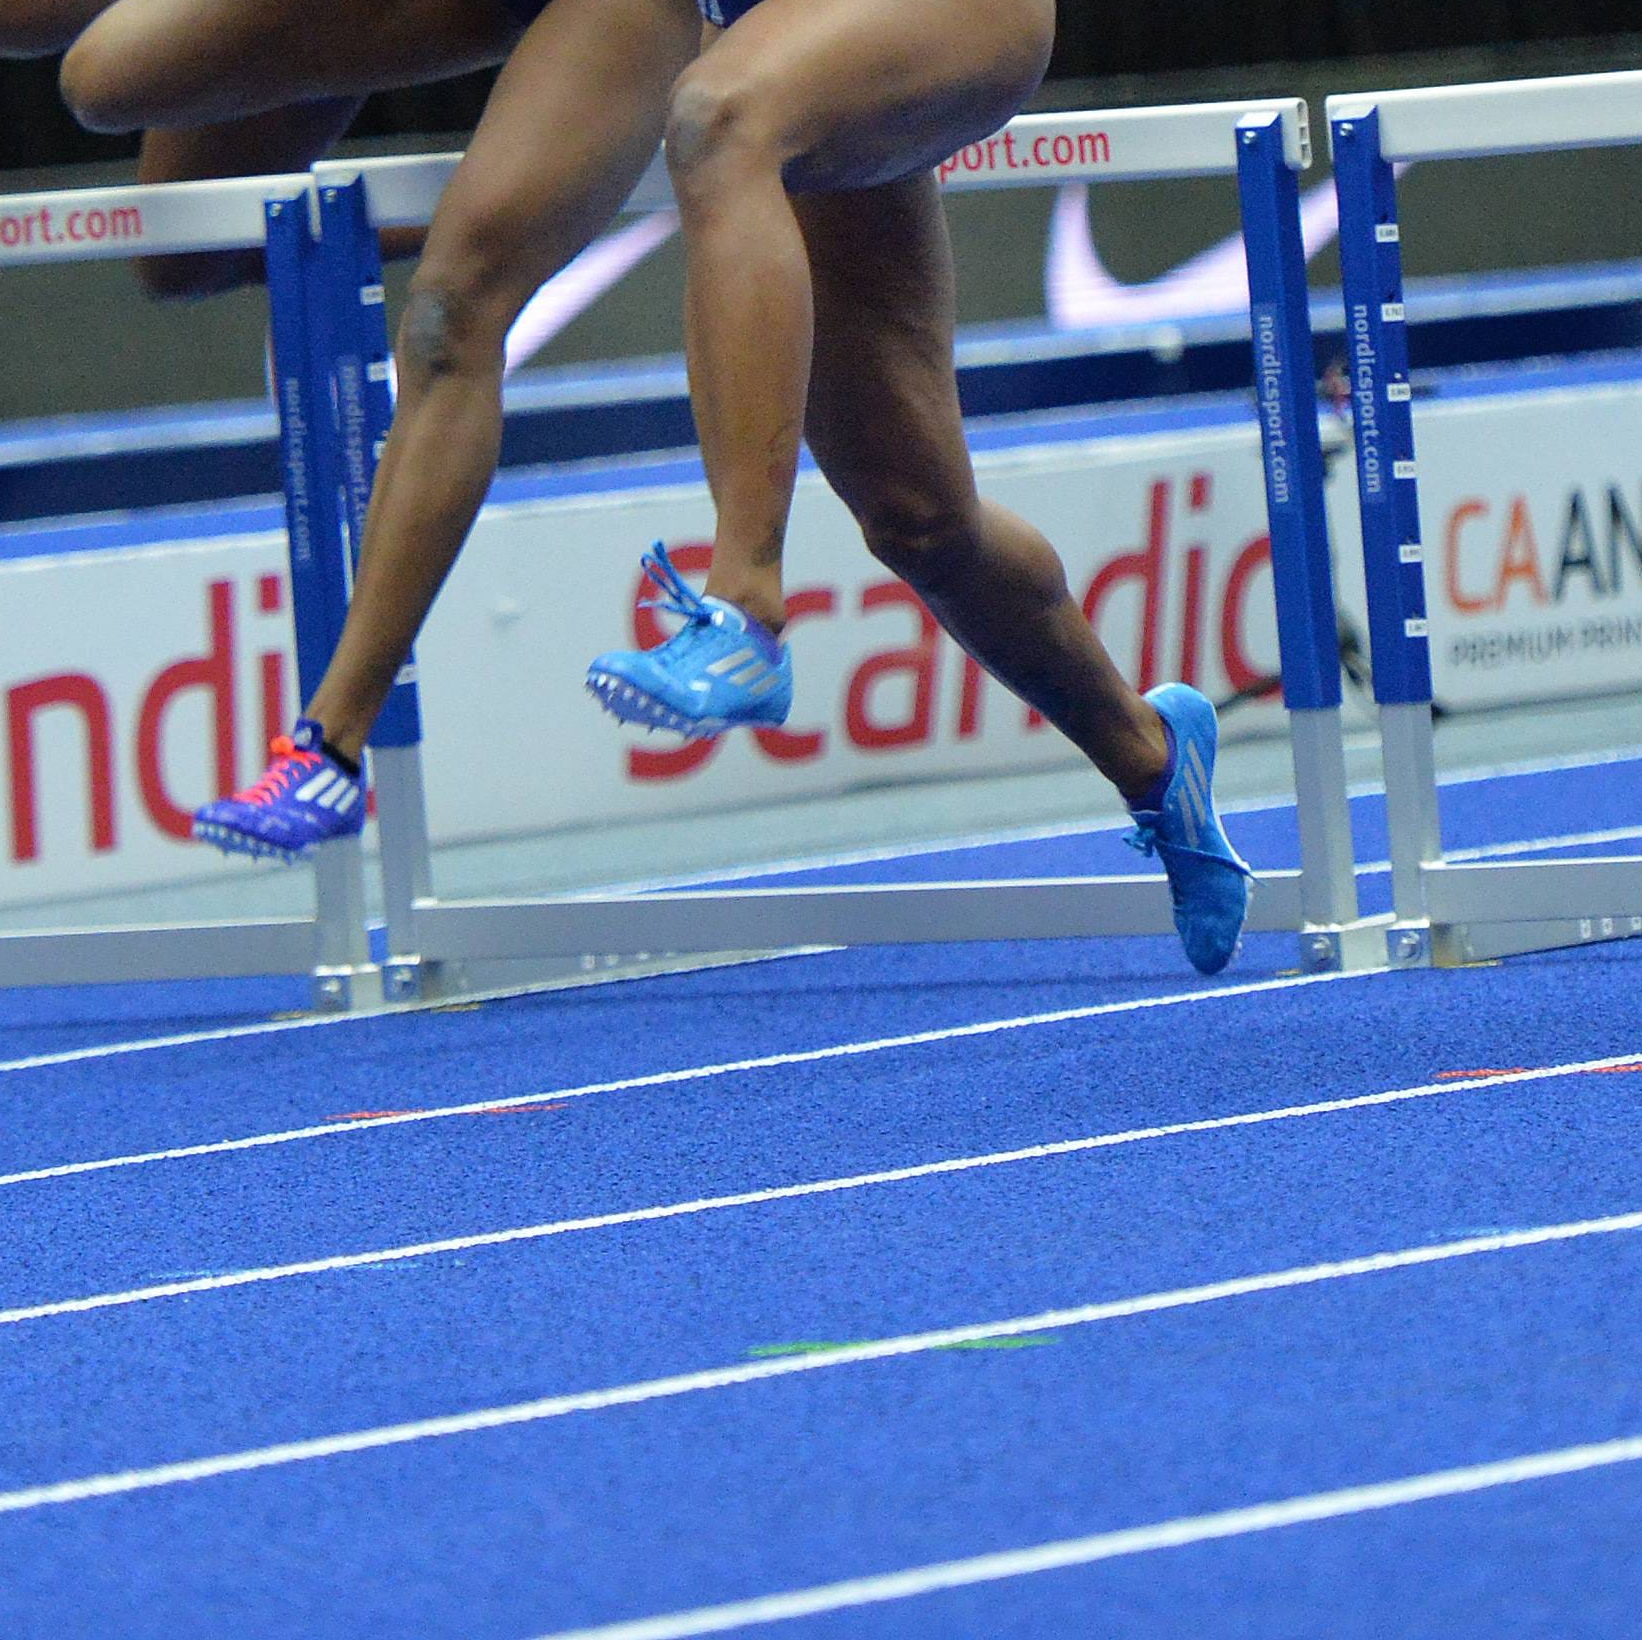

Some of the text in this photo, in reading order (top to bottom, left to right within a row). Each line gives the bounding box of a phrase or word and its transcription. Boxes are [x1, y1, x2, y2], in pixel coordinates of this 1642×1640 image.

[285, 376, 314, 562] nordicsport.com
[1260, 315, 1290, 504] nordicsport.com
[1354, 305, 1382, 493] nordicsport.com
[1451, 622, 1574, 667] PREMIUM
